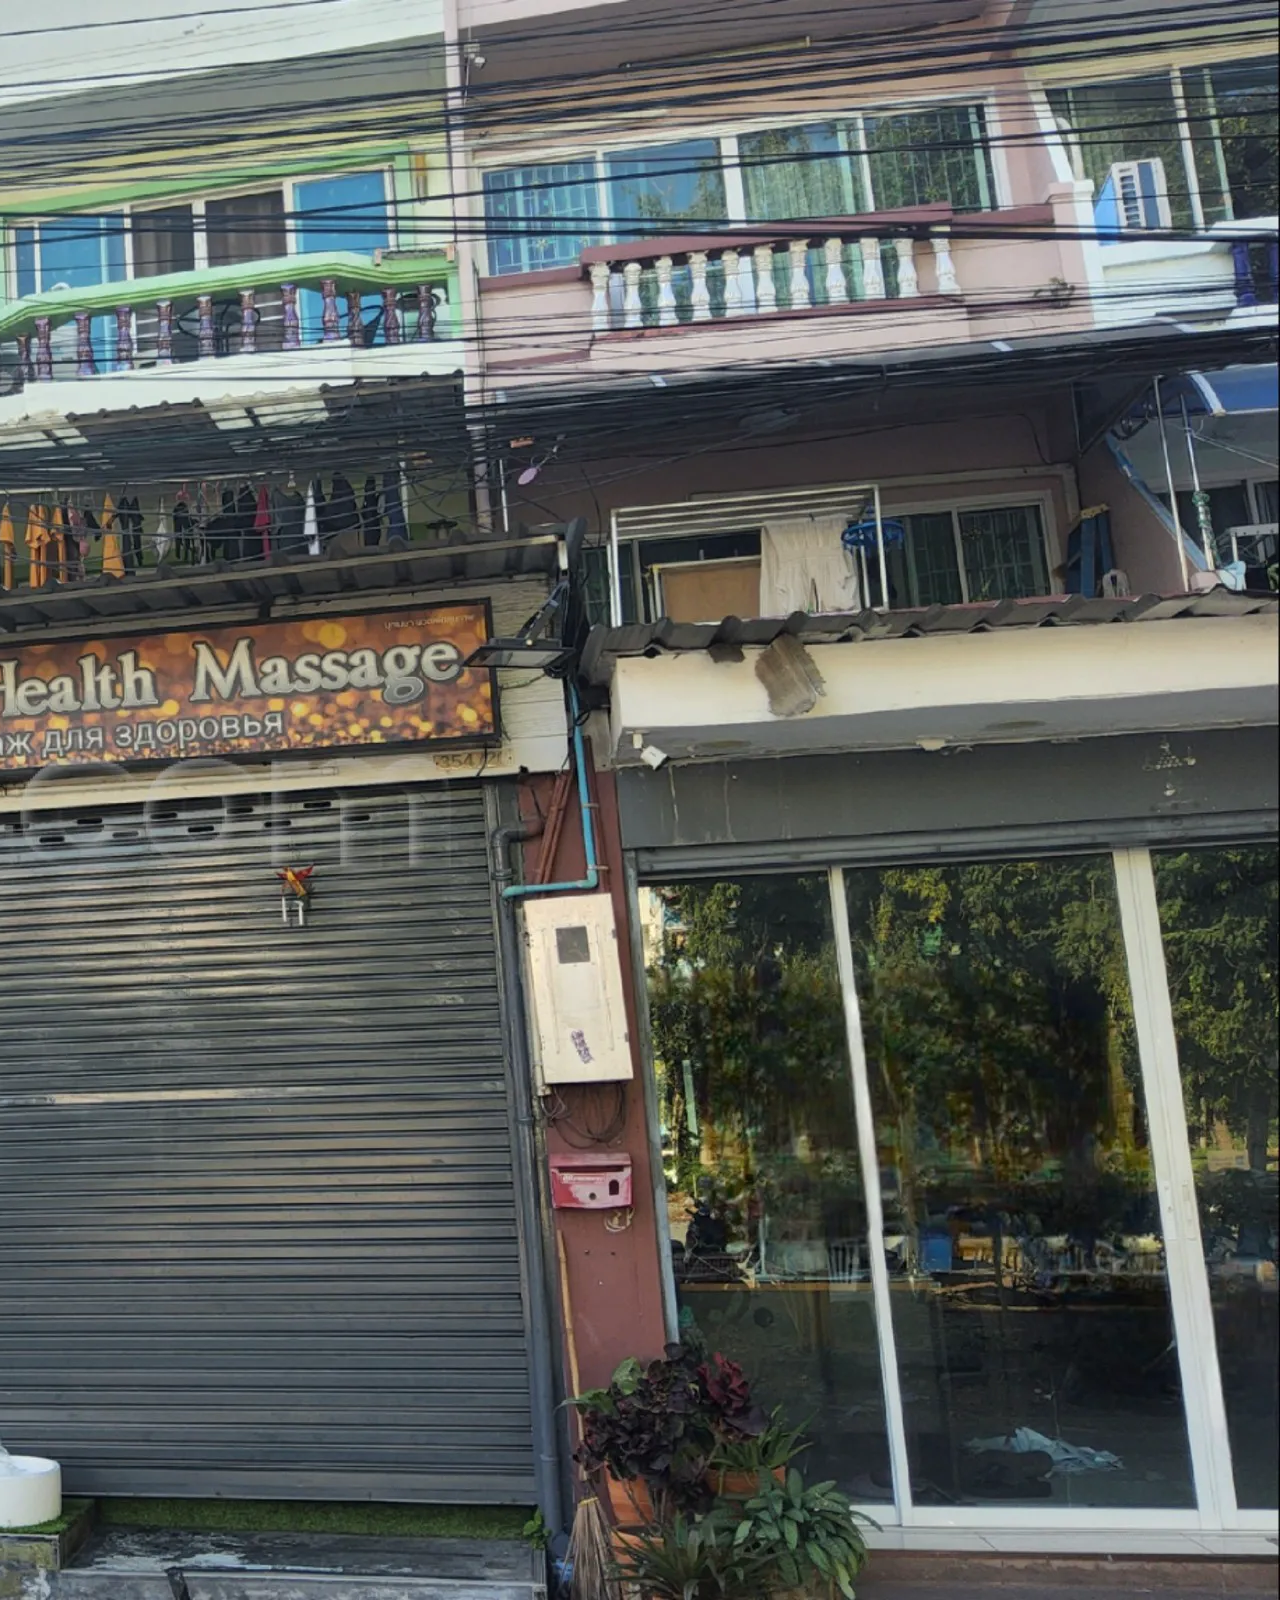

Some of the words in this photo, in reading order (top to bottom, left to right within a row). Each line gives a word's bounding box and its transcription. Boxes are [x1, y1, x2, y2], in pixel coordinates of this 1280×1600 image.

[190, 638, 460, 703] Massage
[41, 726, 104, 757] для
[115, 712, 283, 751] здоровья
